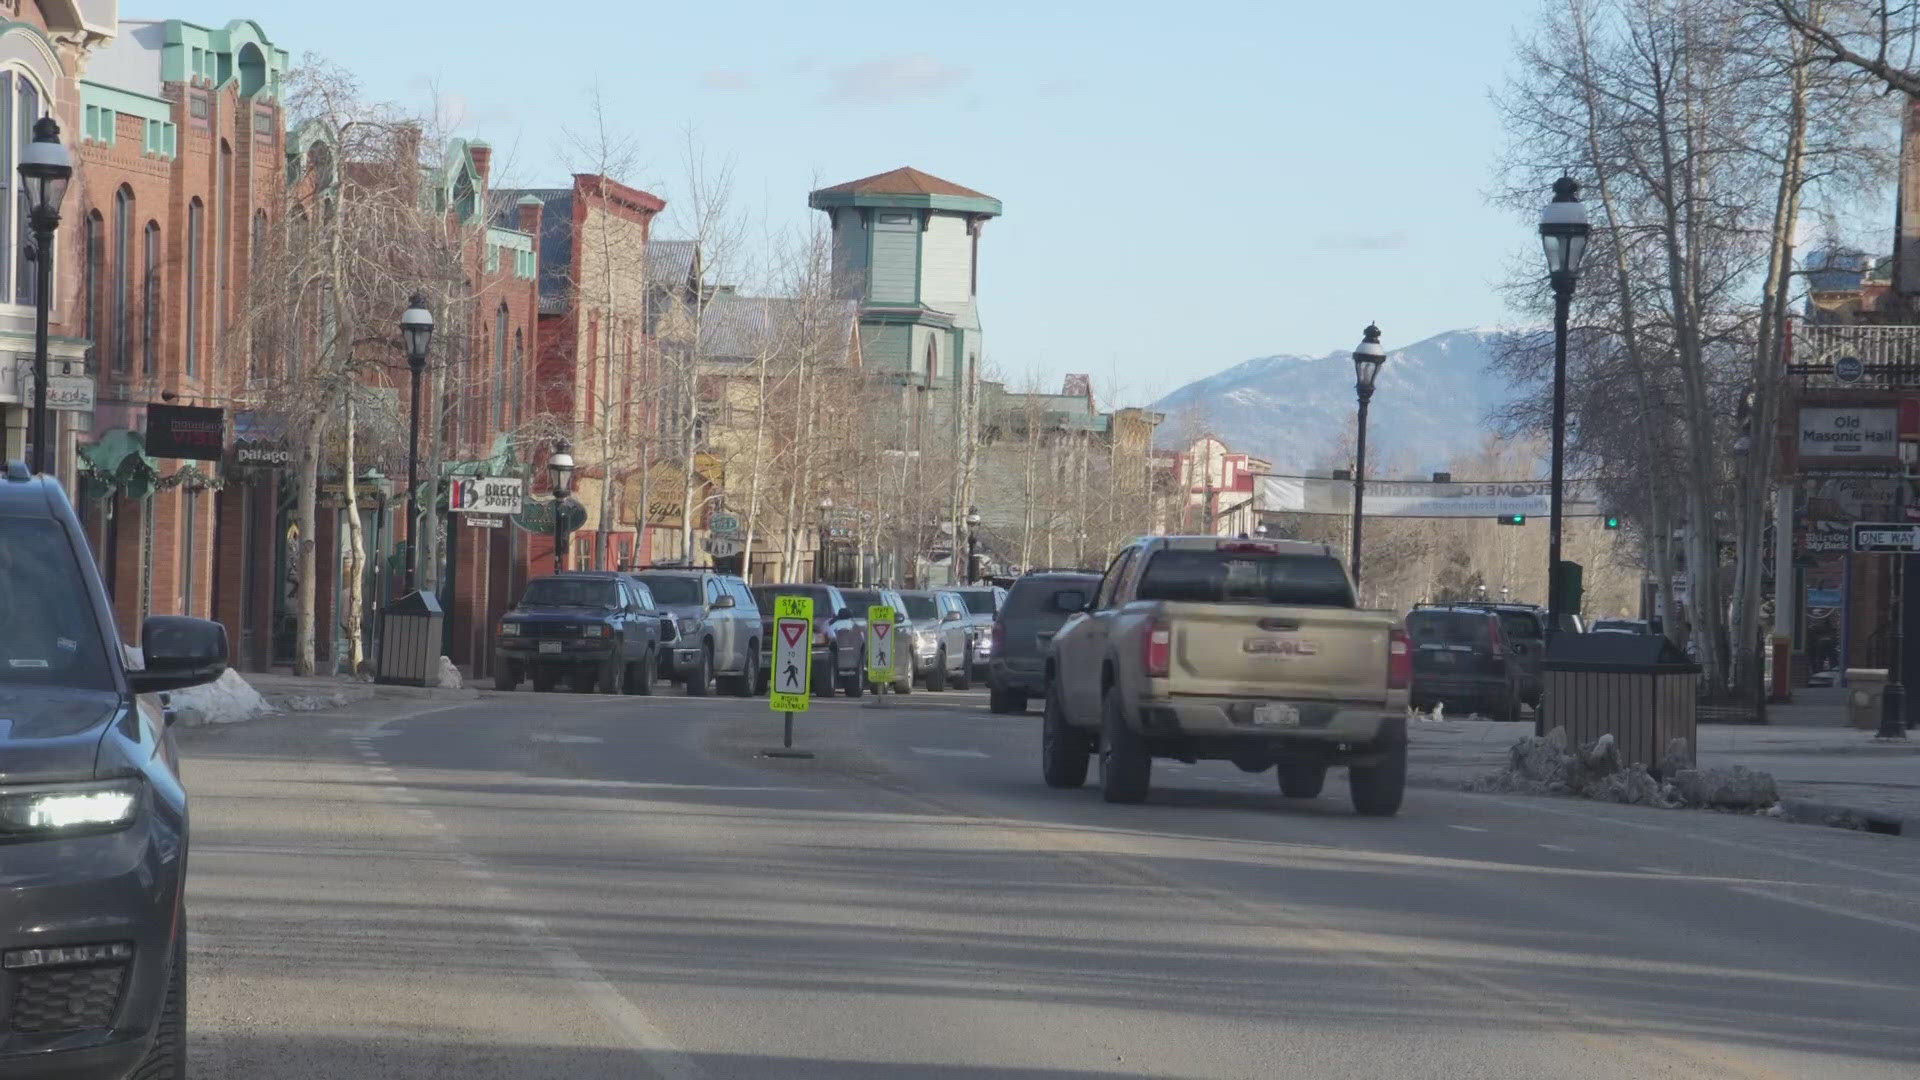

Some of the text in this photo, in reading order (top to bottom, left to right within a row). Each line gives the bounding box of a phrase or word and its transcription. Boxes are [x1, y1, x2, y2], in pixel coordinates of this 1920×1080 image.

[1834, 416, 1860, 428] Old
[1803, 430, 1893, 442] Masonic Hall
[238, 449, 292, 464] patago
[485, 483, 521, 498] BRECK
[484, 497, 517, 508] SPORTS
[1860, 532, 1915, 544] ONE WAY
[782, 599, 806, 608] STATE
[785, 608, 802, 617] LAW
